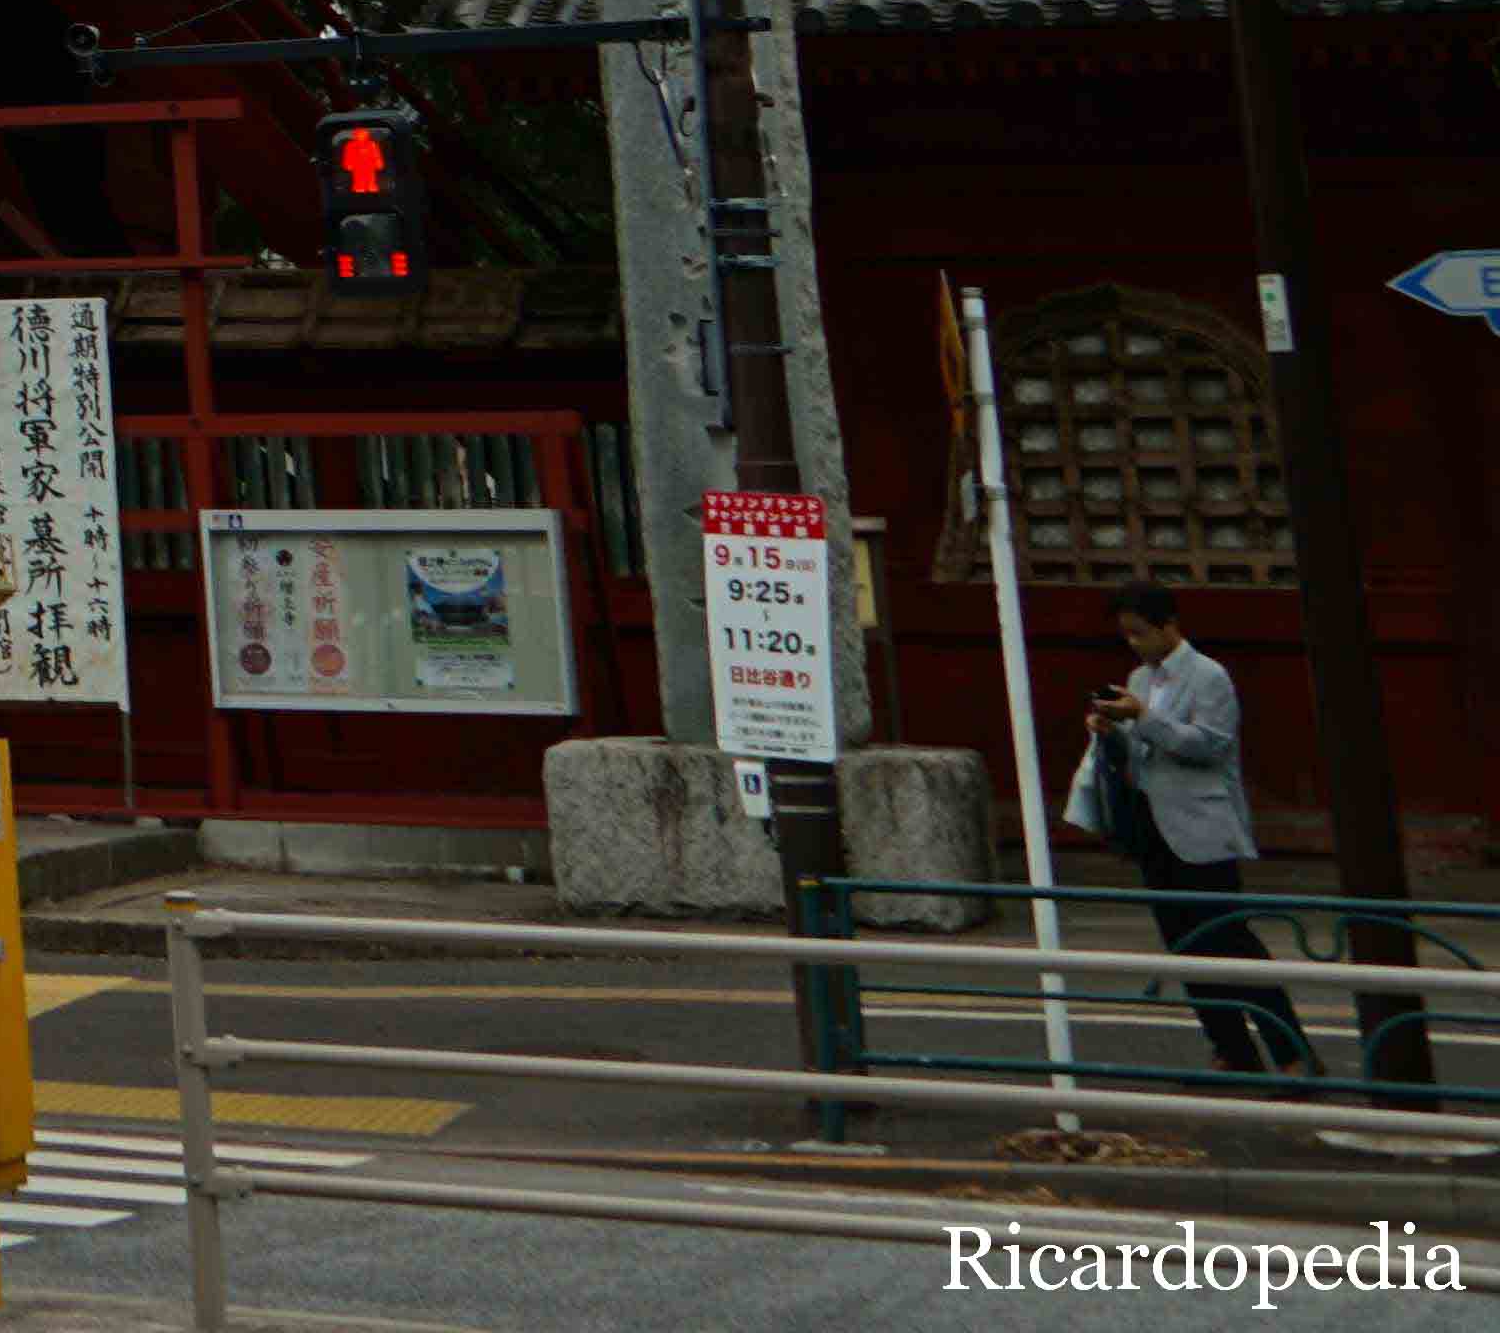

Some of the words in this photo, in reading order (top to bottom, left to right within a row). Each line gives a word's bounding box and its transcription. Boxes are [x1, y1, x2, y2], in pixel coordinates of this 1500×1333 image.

[69, 302, 108, 480] 通期特別公開
[731, 666, 812, 689] 日比谷通り
